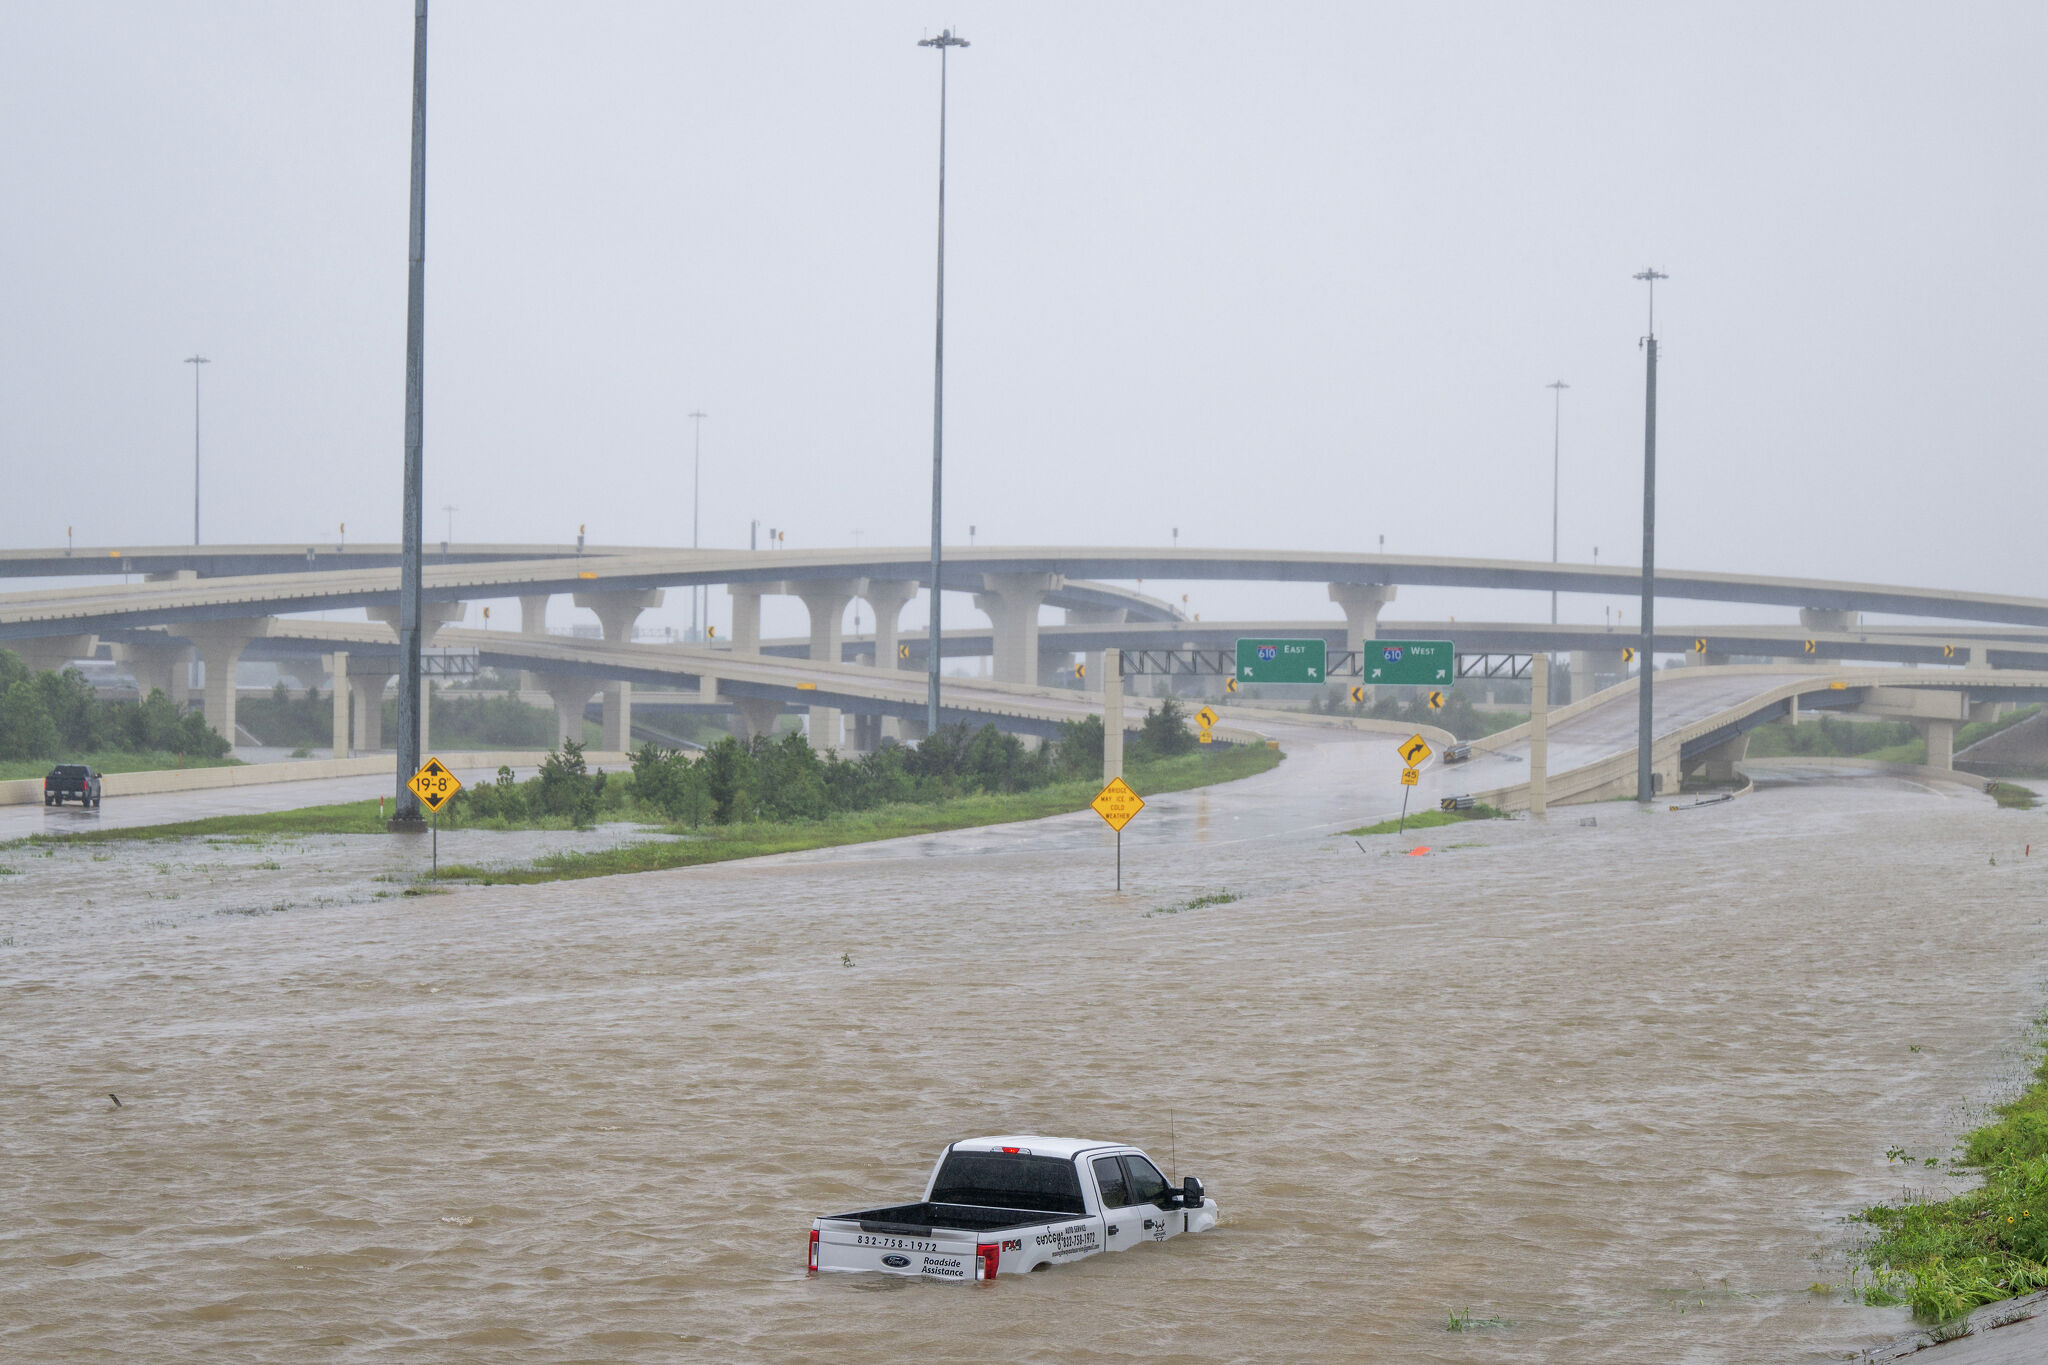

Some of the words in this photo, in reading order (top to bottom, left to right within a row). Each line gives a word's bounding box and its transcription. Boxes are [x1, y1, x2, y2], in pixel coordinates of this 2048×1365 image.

[1258, 648, 1276, 658] 610
[1384, 650, 1402, 660] 610
[1405, 771, 1417, 779] 45
[1064, 1226, 1074, 1235] AUTO
[1074, 1224, 1087, 1234] SERVICE
[857, 1235, 937, 1252] 832-758-1972
[1063, 1231, 1096, 1248] 832-758-1972
[1002, 1239, 1022, 1252] FX4
[887, 1256, 905, 1266] Ford
[923, 1257, 961, 1268] Roadside
[921, 1265, 964, 1277] Assistance
